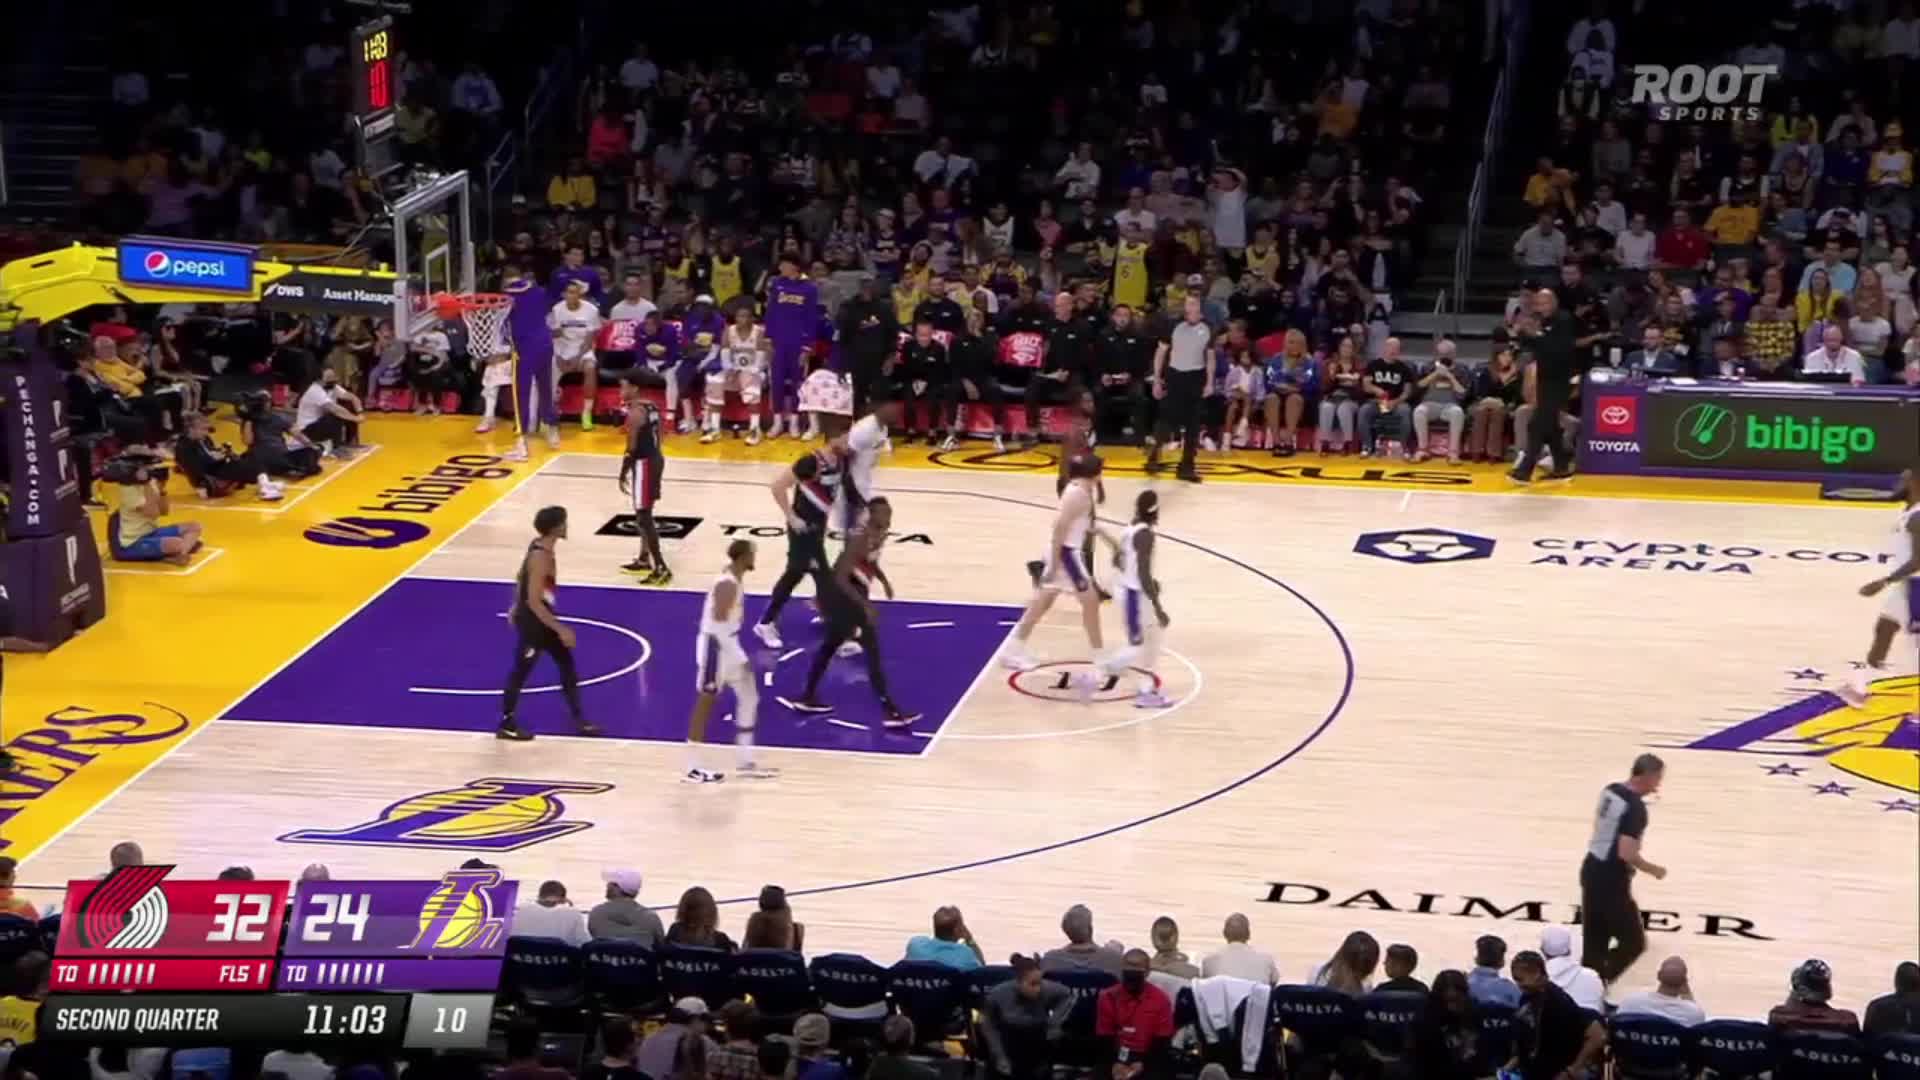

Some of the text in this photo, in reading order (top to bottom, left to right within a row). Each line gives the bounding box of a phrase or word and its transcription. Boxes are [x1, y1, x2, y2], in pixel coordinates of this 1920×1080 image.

[173, 260, 225, 277] pepsi
[323, 288, 352, 300] Asset
[1588, 440, 1640, 452] TOYOTA
[1747, 415, 1875, 463] bibigo
[1102, 461, 1472, 485] EXUS
[358, 455, 512, 513] bibigo
[1531, 554, 1753, 574] ARENA
